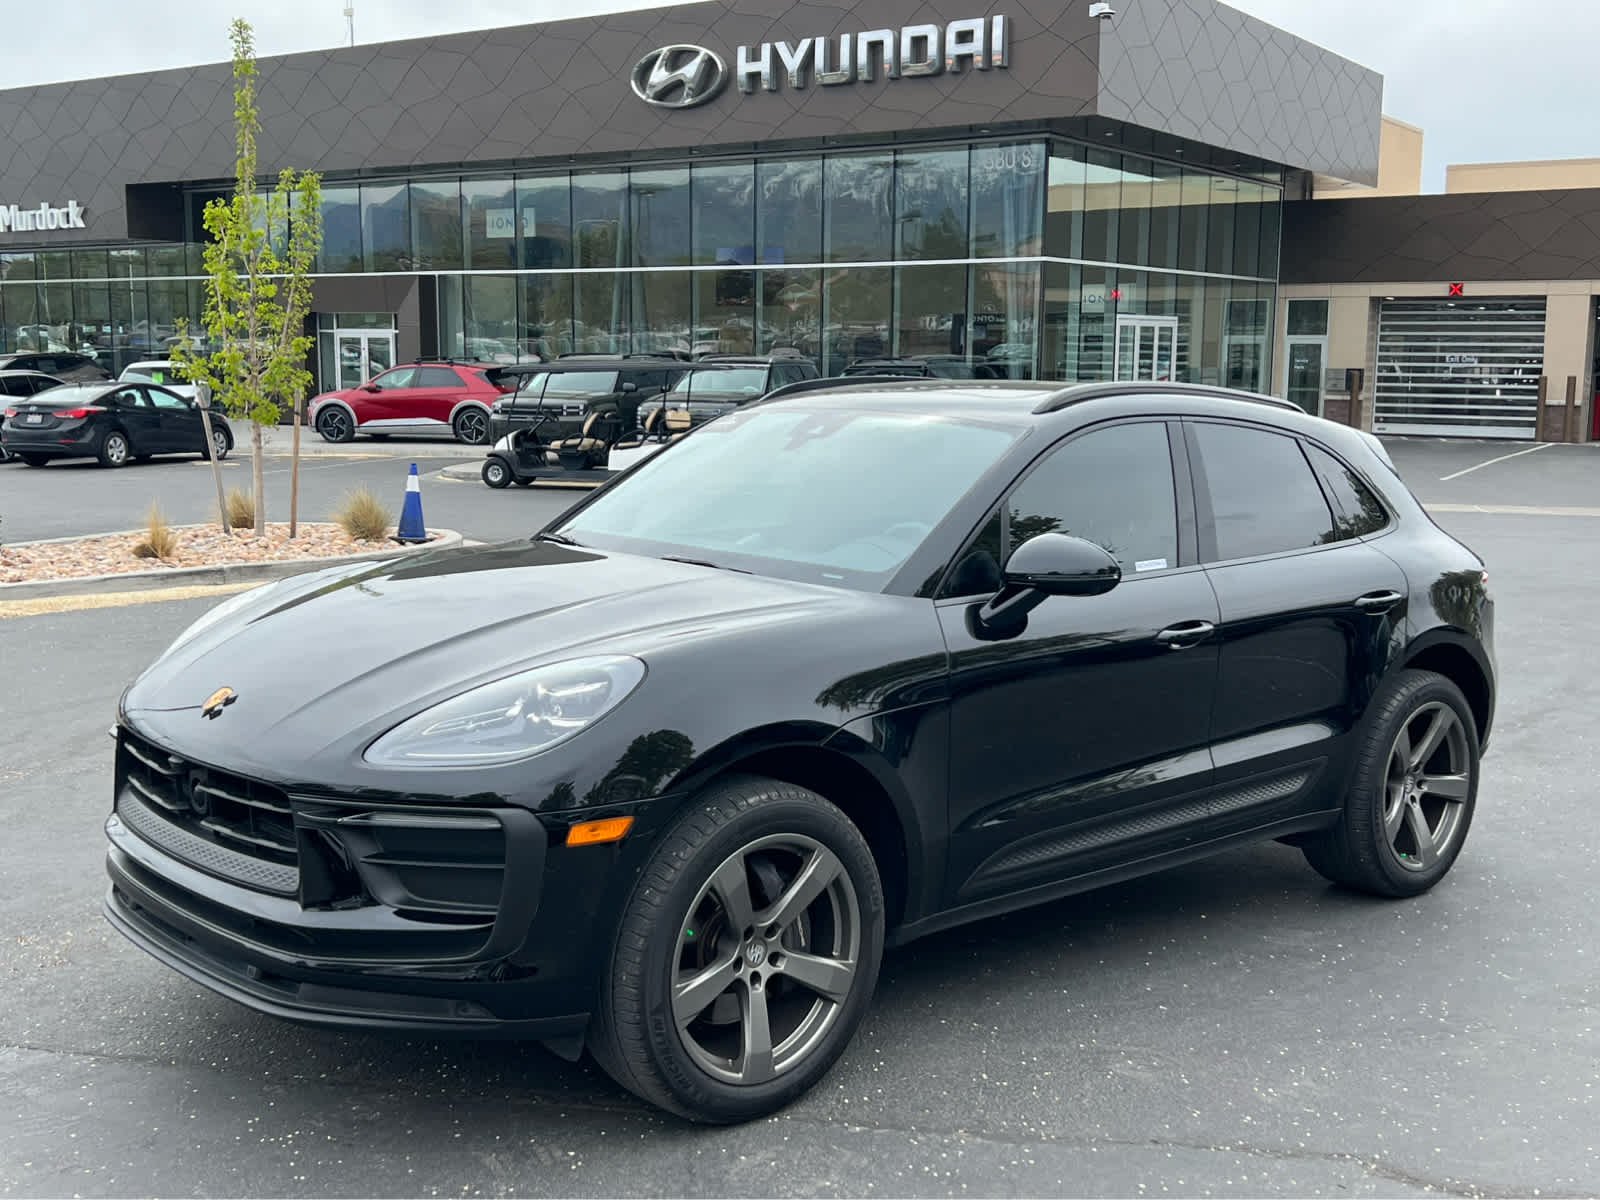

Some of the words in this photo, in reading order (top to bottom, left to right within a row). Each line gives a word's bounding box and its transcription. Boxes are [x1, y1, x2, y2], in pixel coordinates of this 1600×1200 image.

[736, 14, 1009, 94] HYUNDAI
[0, 200, 87, 232] Murdock
[491, 216, 529, 229] ION
